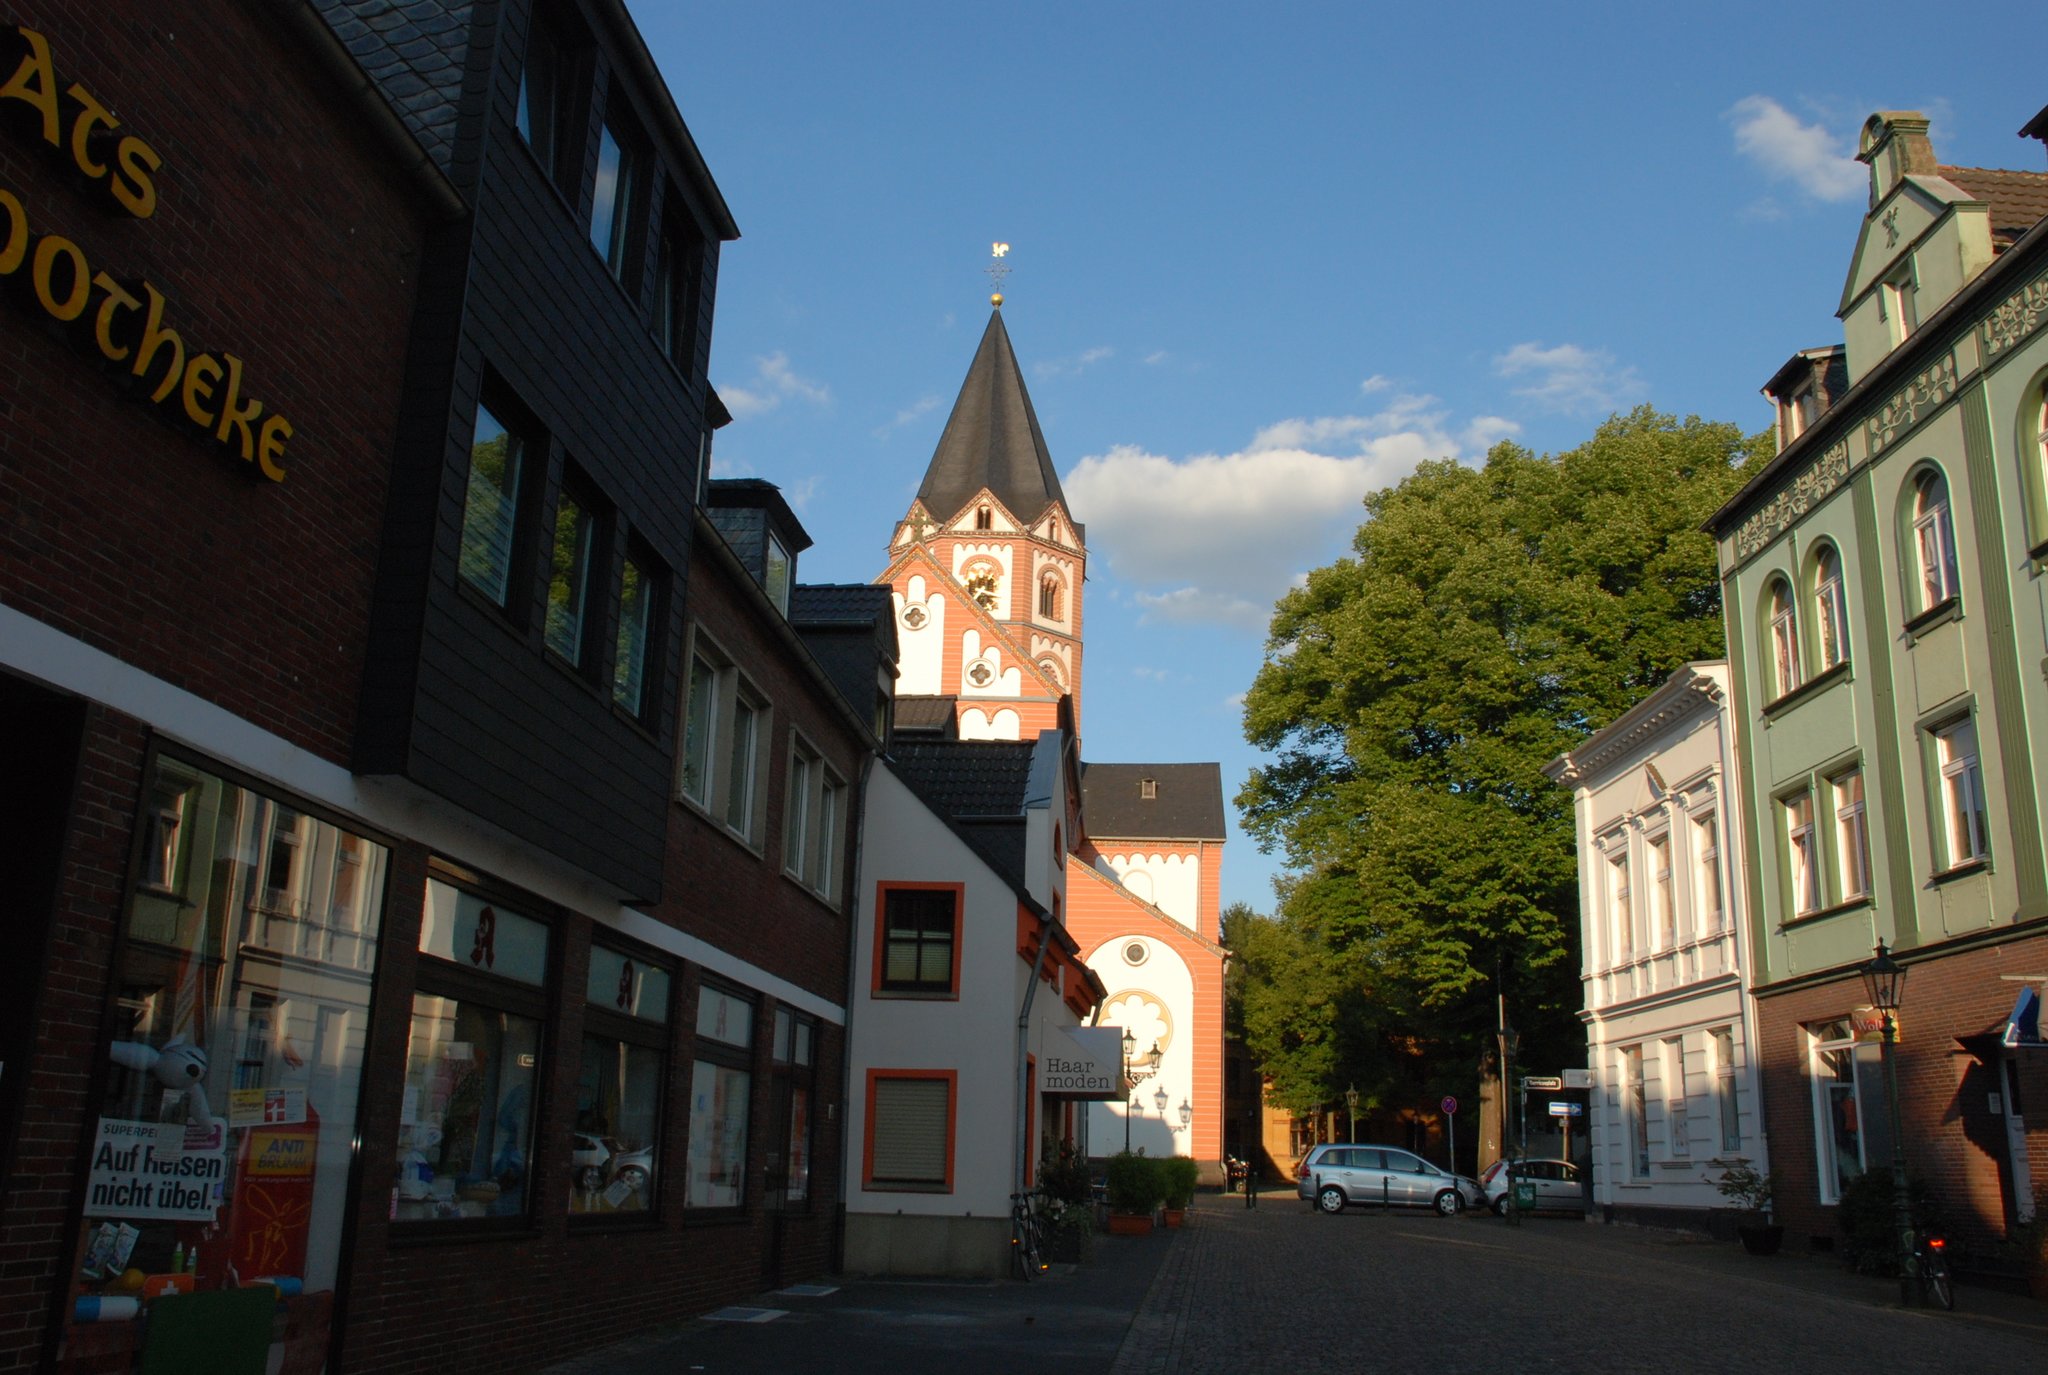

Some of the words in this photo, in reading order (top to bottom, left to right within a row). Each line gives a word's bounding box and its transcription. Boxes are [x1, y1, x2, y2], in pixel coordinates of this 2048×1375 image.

[1046, 1058, 1095, 1073] Haar
[1046, 1074, 1110, 1089] moden
[94, 1141, 140, 1172] Auf
[92, 1176, 153, 1207] nicht
[157, 1180, 212, 1210] übel.
